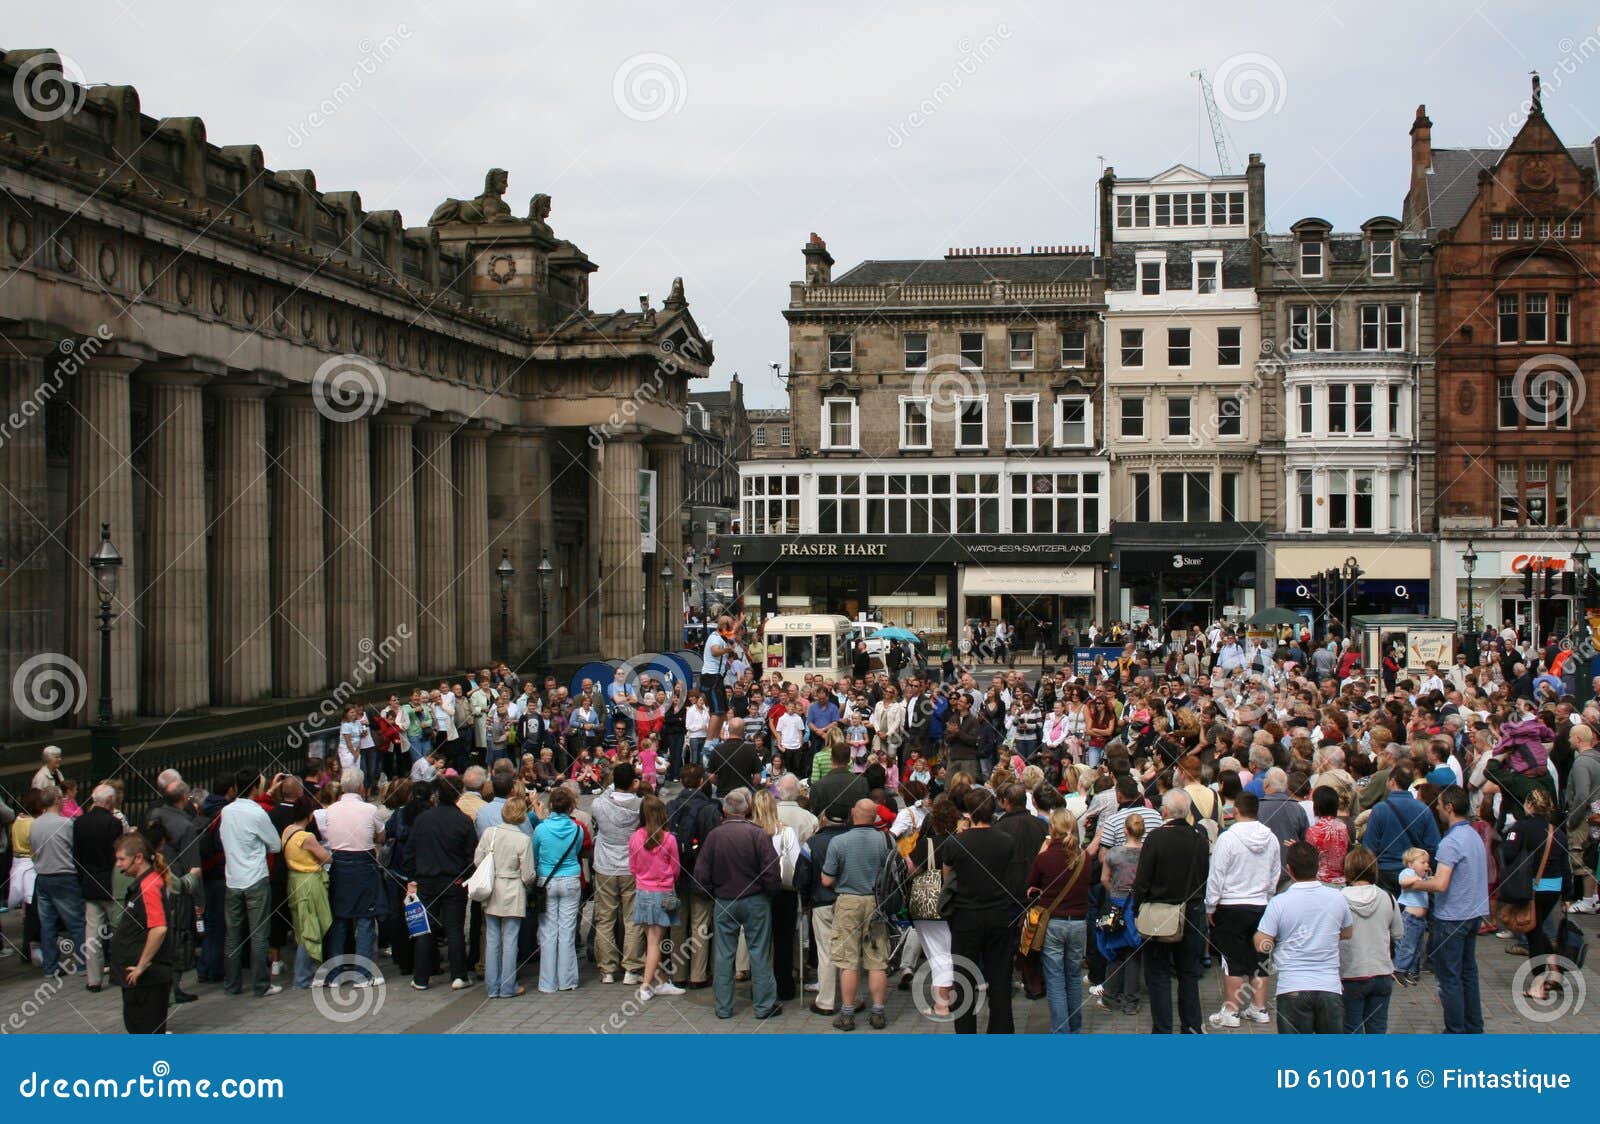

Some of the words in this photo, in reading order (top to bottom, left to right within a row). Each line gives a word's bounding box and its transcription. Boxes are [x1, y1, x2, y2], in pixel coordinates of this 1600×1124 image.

[732, 544, 742, 556] 77
[780, 543, 838, 556] FRASER
[844, 543, 888, 556] HART
[967, 544, 1014, 553] WATCHES
[1022, 544, 1091, 553] SWITZERLAND
[1172, 554, 1184, 568] 3
